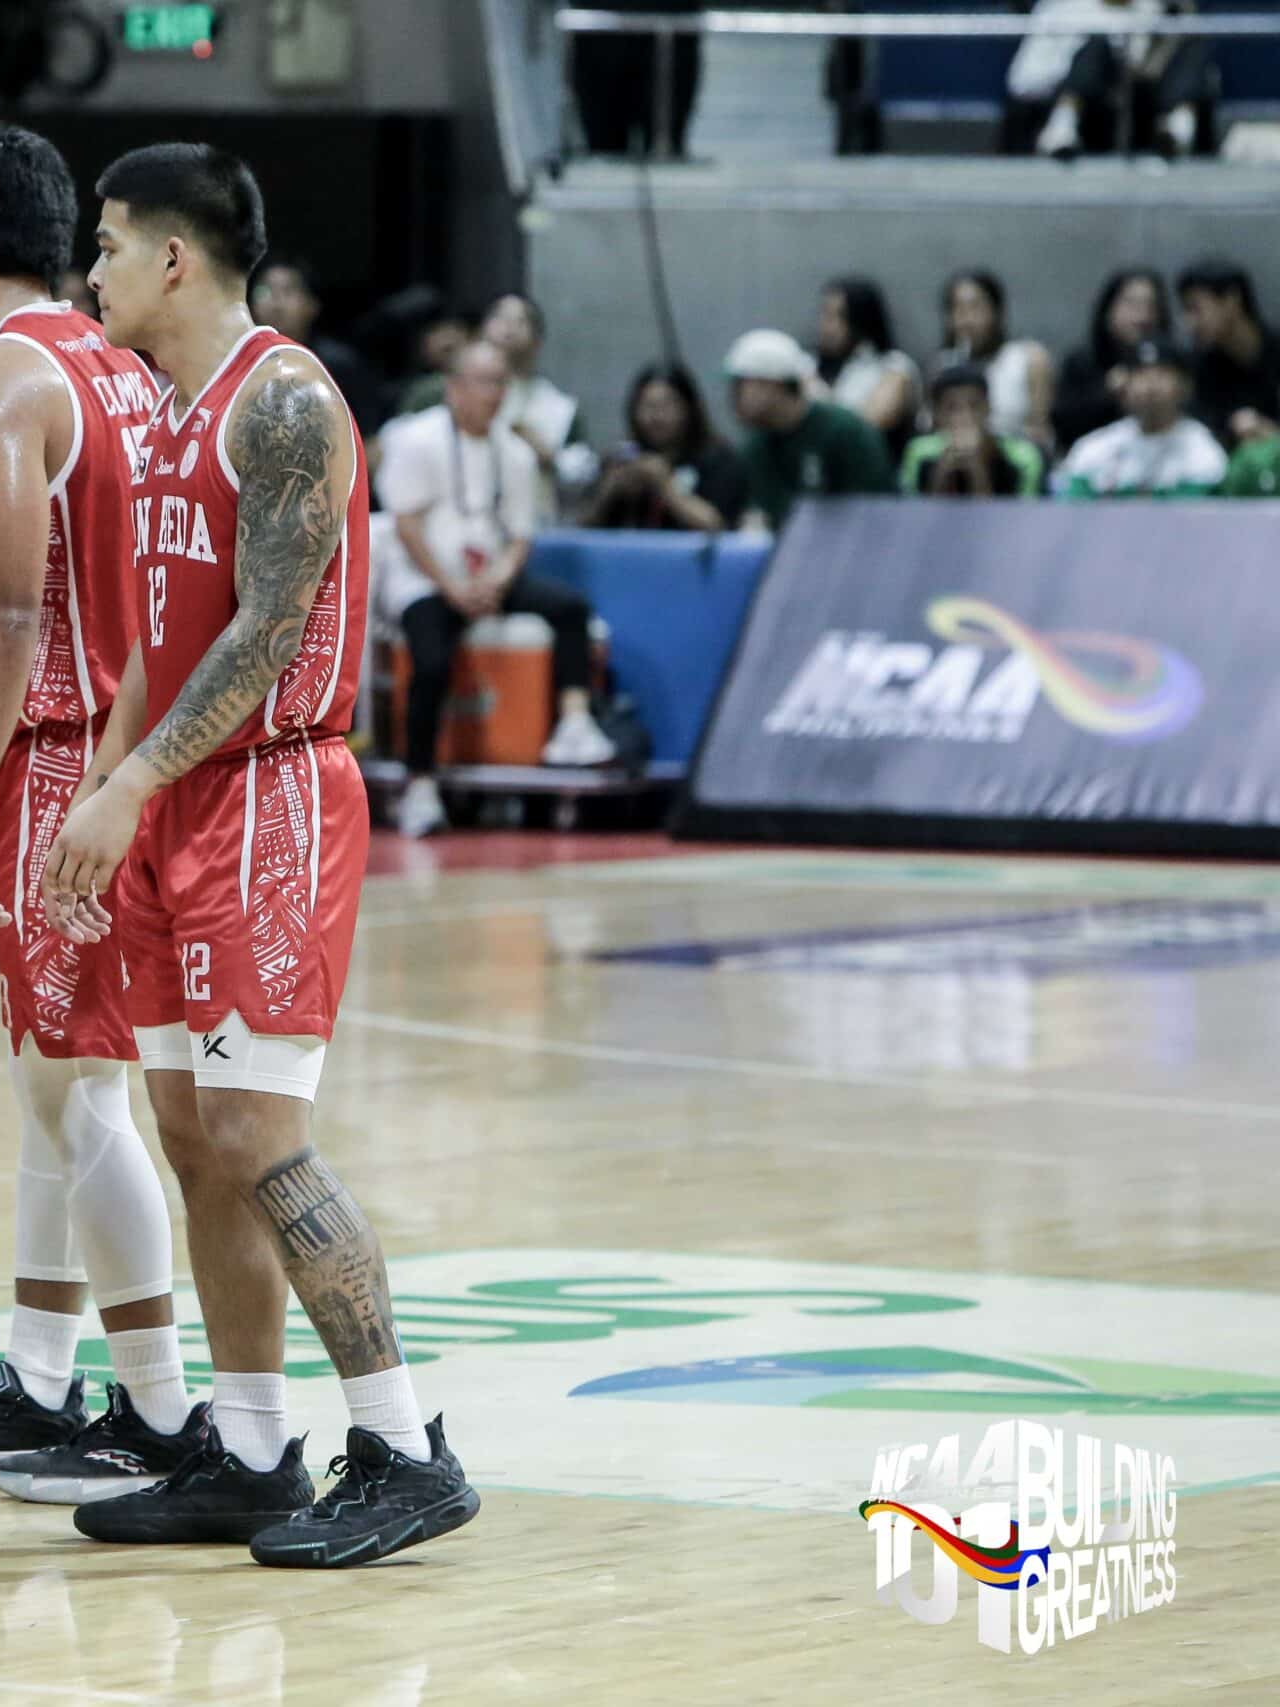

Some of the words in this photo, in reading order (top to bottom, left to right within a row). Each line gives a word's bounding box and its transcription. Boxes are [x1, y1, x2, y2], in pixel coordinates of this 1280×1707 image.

[148, 565, 167, 648] 12
[790, 632, 1042, 718] NCAA
[182, 942, 211, 1000] 12
[257, 1157, 344, 1232] AGAINS
